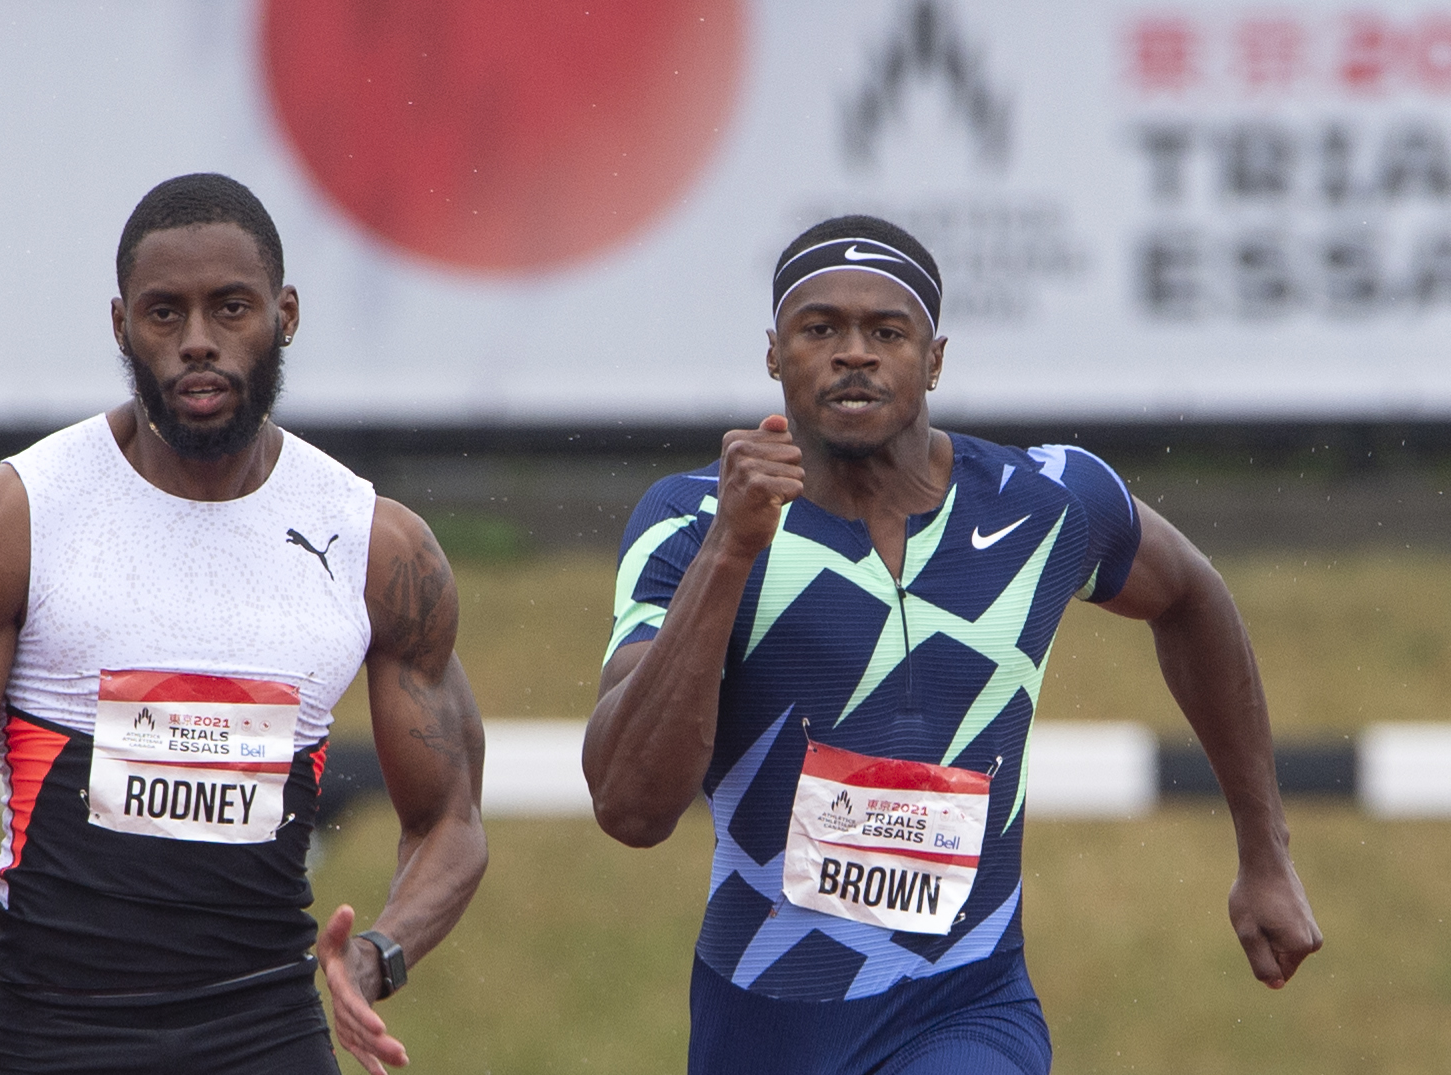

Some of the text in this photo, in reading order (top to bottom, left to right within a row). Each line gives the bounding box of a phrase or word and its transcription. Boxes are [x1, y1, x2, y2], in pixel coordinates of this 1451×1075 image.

[168, 726, 229, 742] TRIALS
[168, 740, 230, 755] ESSAIS
[240, 743, 266, 758] Bell
[123, 775, 258, 825] RODNEY
[865, 812, 927, 830] TRIALS
[861, 825, 924, 844] ESSAIS
[933, 833, 961, 850] Bell
[818, 857, 943, 916] BROWN
